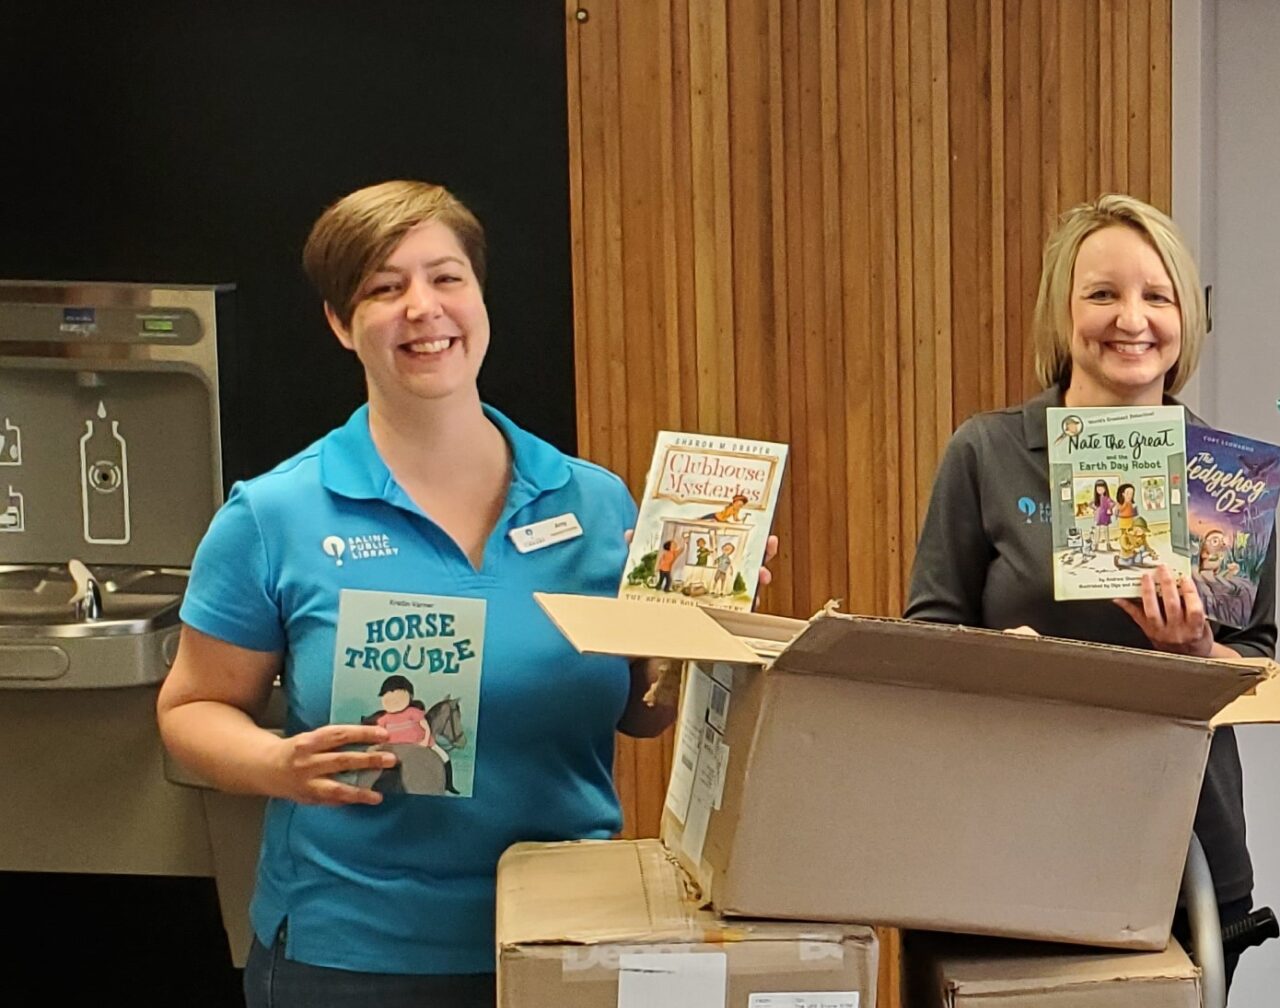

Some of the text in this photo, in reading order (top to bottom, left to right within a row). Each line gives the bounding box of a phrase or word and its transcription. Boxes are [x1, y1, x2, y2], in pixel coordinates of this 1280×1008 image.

[675, 438, 771, 454] SHARON DRAPER
[1069, 433, 1101, 454] Nate
[1128, 429, 1175, 459] Great
[1079, 461, 1162, 471] Earth Day Robot
[1197, 452, 1214, 464] The
[669, 453, 766, 482] Clubhouse
[666, 474, 761, 501] Mysteries
[1216, 493, 1245, 513] Oz
[348, 534, 390, 545] SALINA
[350, 541, 390, 551] PUBLIC
[352, 548, 399, 559] LIBRARY
[366, 613, 455, 643] HORSE
[345, 639, 476, 674] TROUBLE
